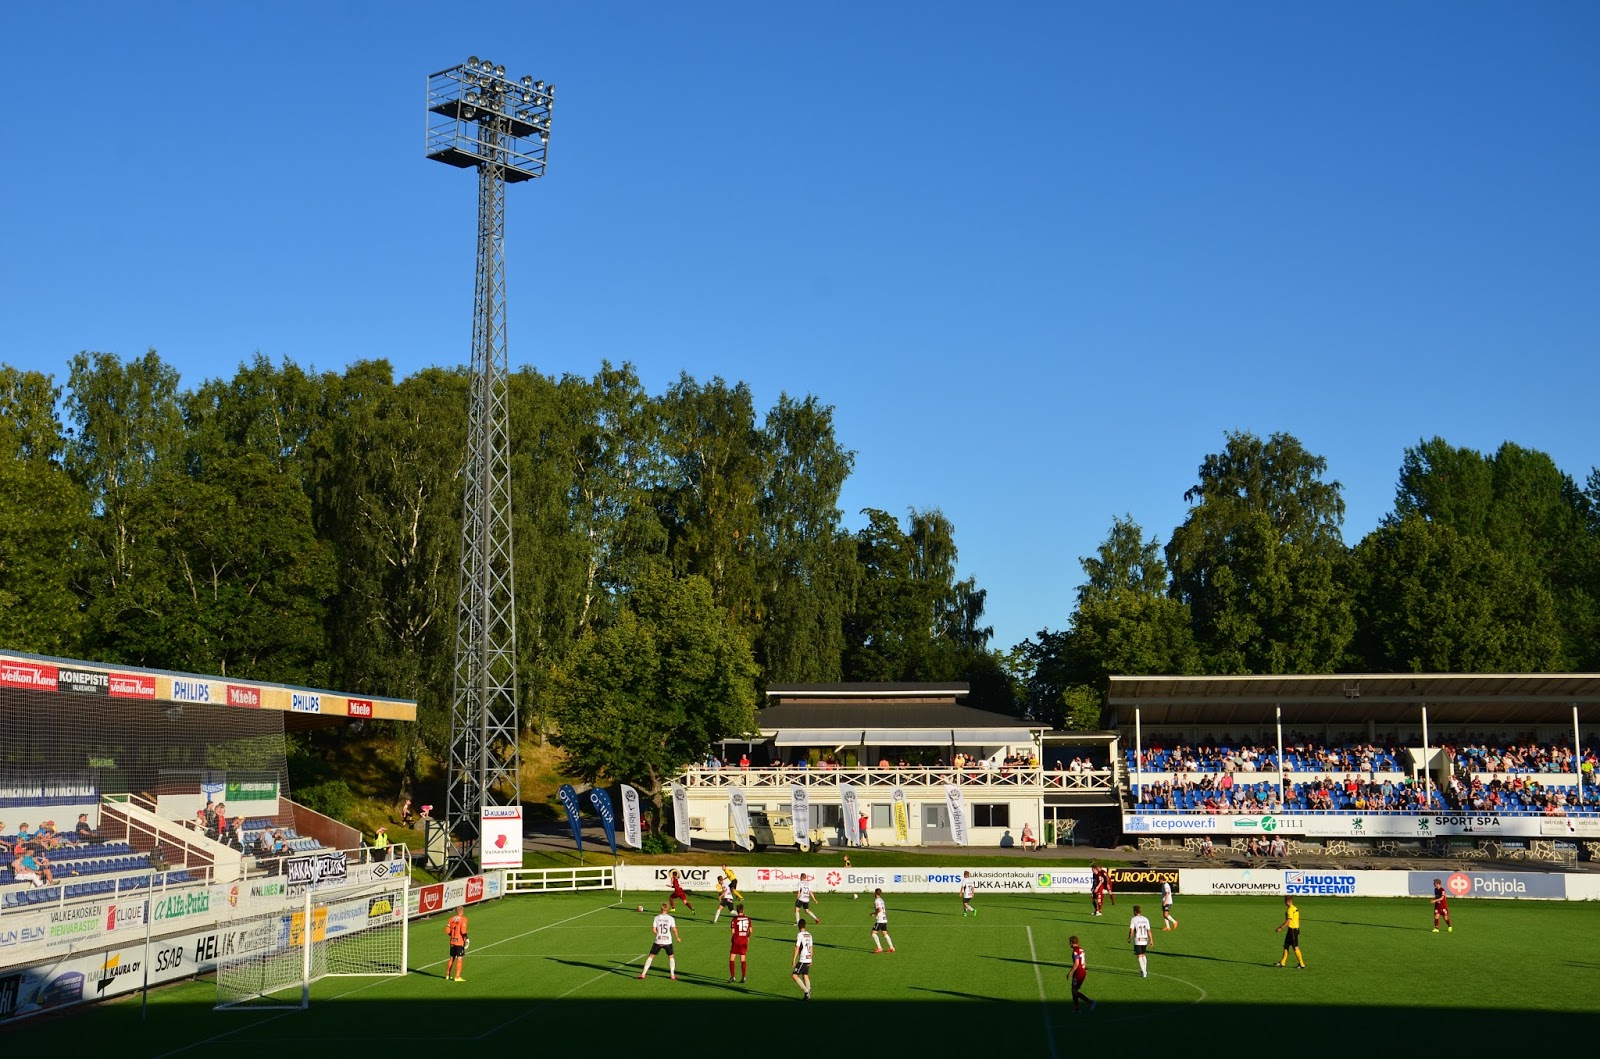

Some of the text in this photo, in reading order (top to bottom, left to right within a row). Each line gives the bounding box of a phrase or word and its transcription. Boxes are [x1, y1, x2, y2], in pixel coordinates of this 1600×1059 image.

[1, 669, 57, 686] Veikon Kone
[59, 670, 109, 687] KONEPISTE
[110, 680, 154, 695] Veikon Kone
[174, 681, 210, 702] PHILIPS
[231, 688, 257, 705] Miele
[293, 694, 319, 712] PHILIPS
[350, 703, 370, 716] Miele
[1152, 817, 1216, 830] icepower.fi
[1435, 817, 1500, 825] SPORT SPA
[847, 874, 885, 884] Bemis
[968, 871, 1034, 879] ukkasidontakoulu
[1052, 876, 1094, 884] EUROMAST
[1305, 876, 1356, 885] HUOLTO
[972, 881, 1032, 889] UKKA-HAKA
[1212, 882, 1281, 890] KAIVOPUMPPU
[1286, 885, 1349, 894] SYSTEEMI
[1474, 877, 1526, 895] Pohjola
[50, 906, 102, 923] VALKEAKOSKEN
[116, 906, 142, 922] CLIQUE
[659, 923, 668, 935] 15
[737, 920, 748, 932] 15
[1139, 925, 1147, 936] 11
[21, 926, 45, 940] SUN
[155, 947, 183, 972] SSAB
[132, 961, 142, 972] OY
